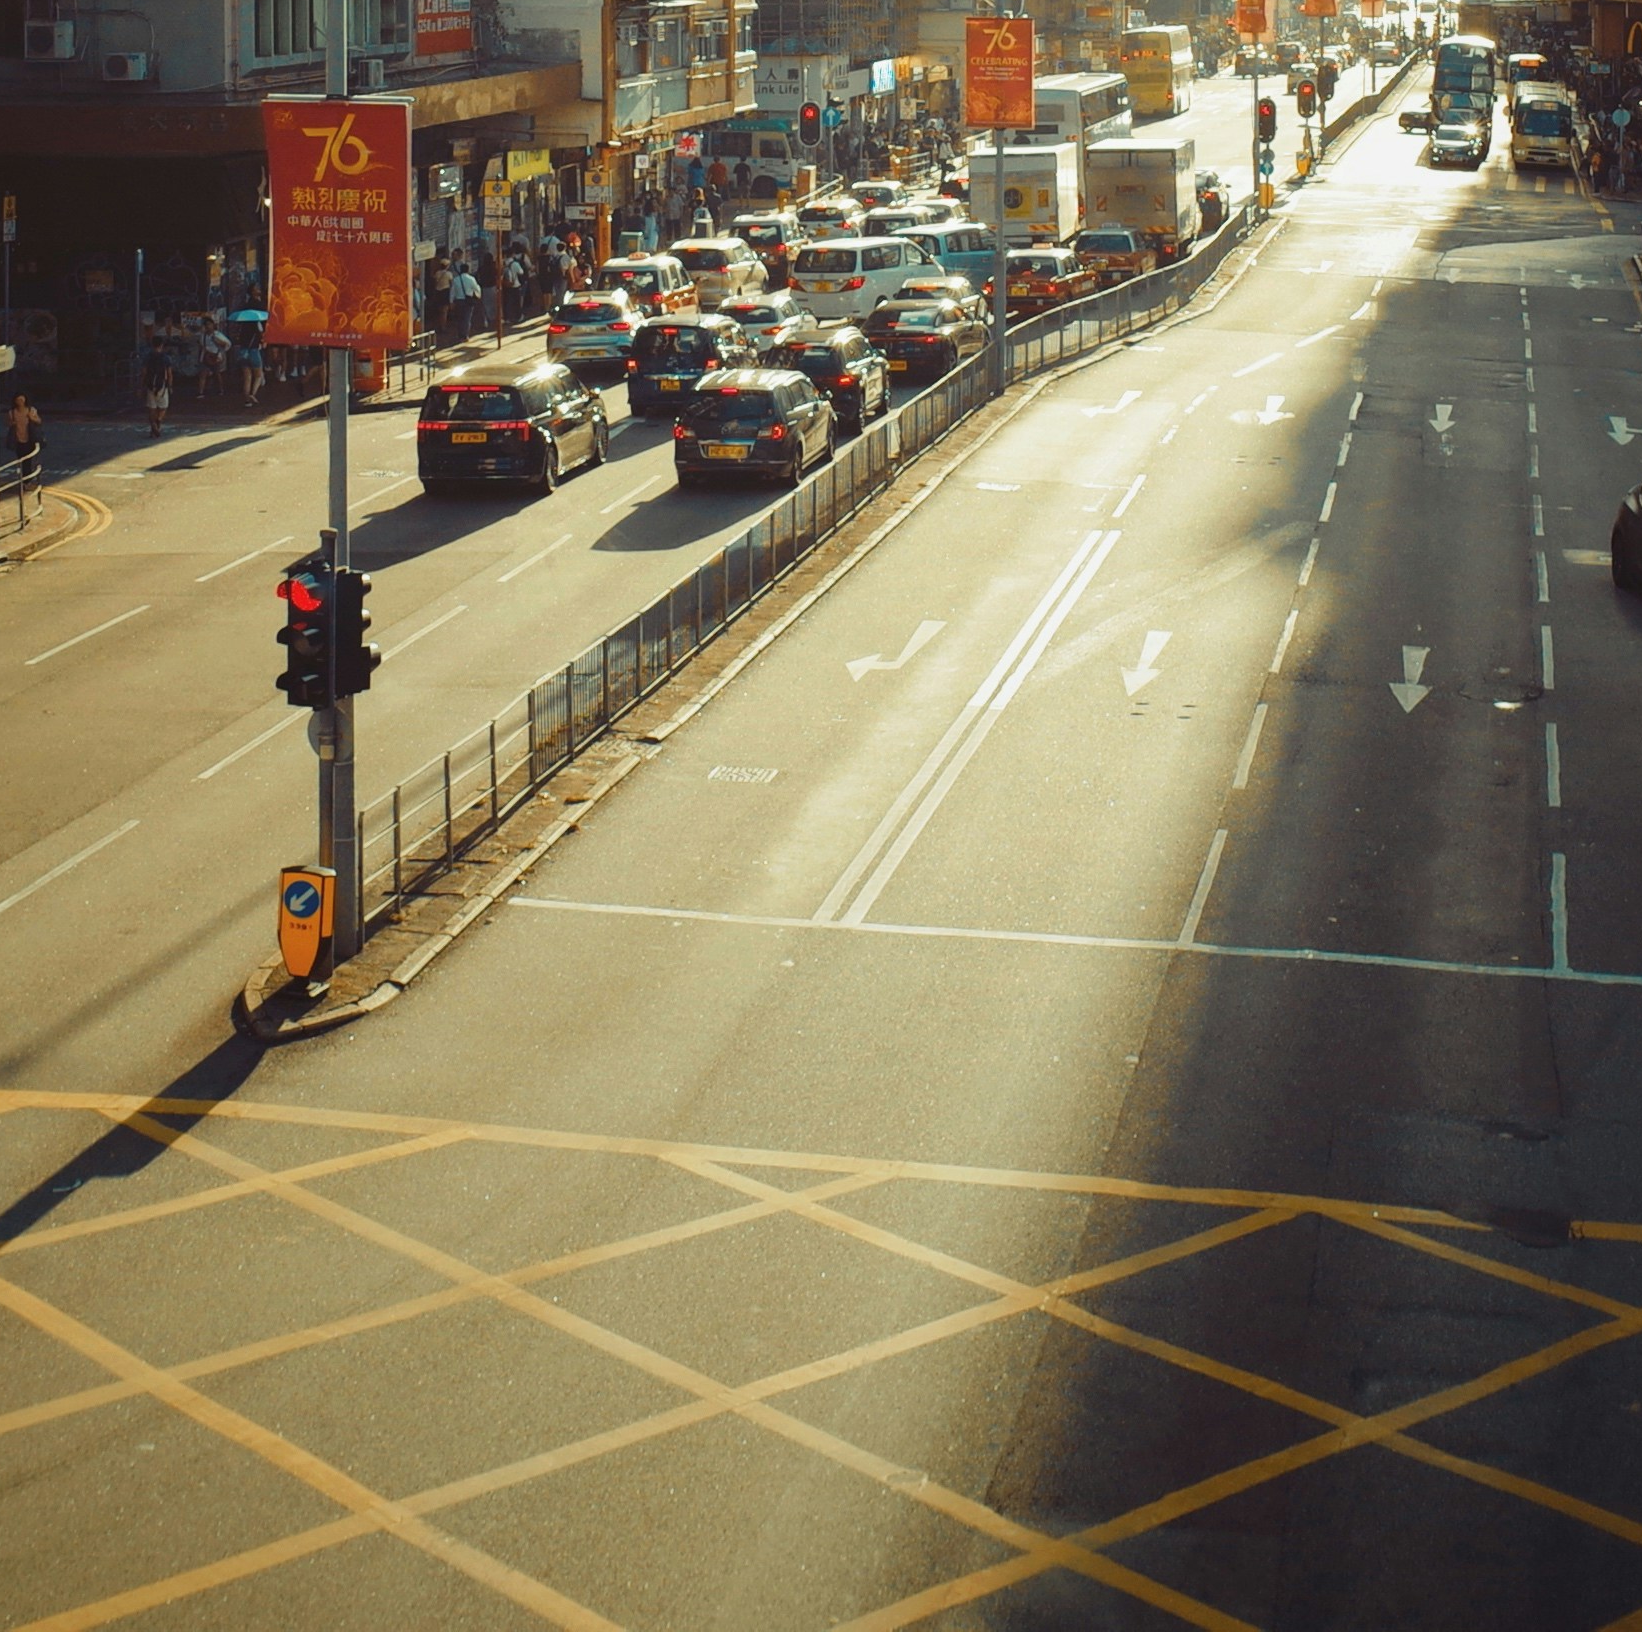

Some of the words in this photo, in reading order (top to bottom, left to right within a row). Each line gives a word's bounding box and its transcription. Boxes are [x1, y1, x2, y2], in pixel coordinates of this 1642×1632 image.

[982, 21, 1018, 55] 76
[970, 56, 1028, 66] CELEBRATING
[779, 84, 799, 95] Life
[301, 112, 371, 183] 76
[291, 187, 388, 213] 熱烈慶祝
[287, 214, 365, 229] 中華人民共和國
[316, 229, 394, 244] 成立七十六周年
